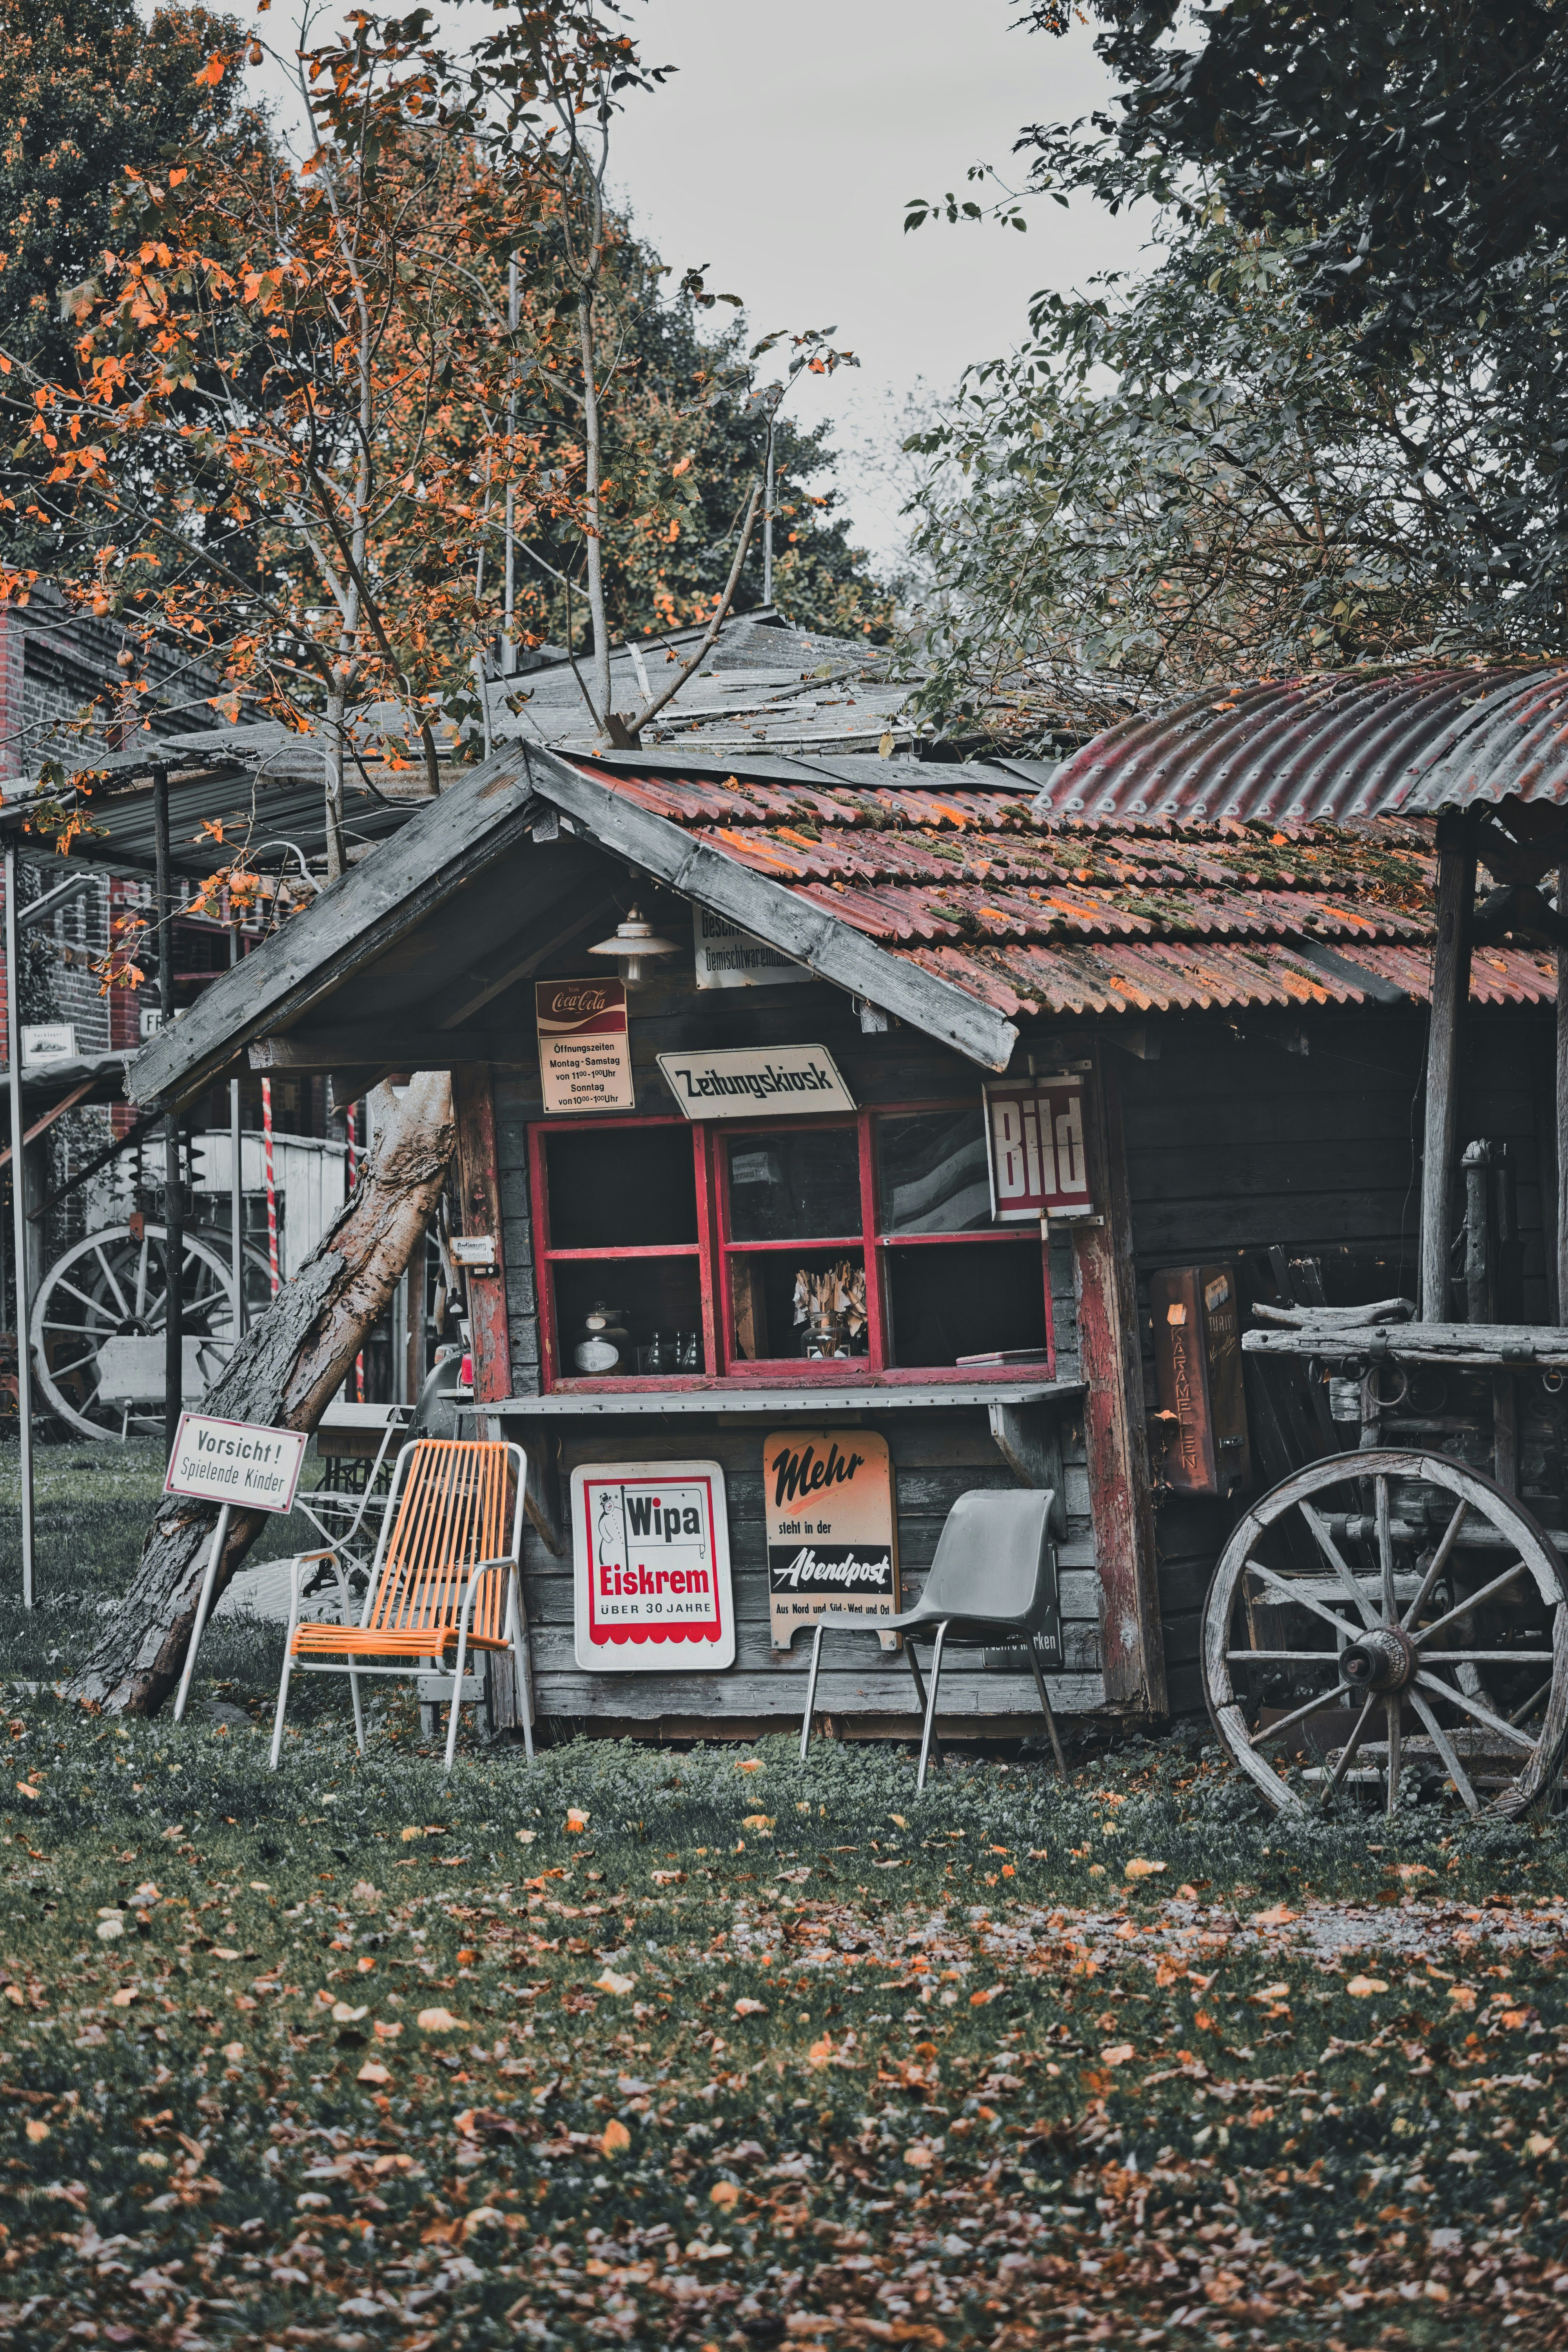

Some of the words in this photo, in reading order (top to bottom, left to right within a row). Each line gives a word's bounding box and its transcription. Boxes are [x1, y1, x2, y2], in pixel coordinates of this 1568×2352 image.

[552, 989, 607, 1012] Coca-Cola
[554, 1043, 614, 1053] Öffnungszeiten
[571, 1083, 604, 1092] Sonntag
[675, 1062, 833, 1098] Zeitungskiosk
[992, 1098, 1087, 1198] Bild
[1171, 1327, 1197, 1469] KARAMELLEN
[198, 1430, 282, 1464] Vorsicht!
[181, 1457, 239, 1484] Spielende
[245, 1468, 285, 1492] Kinder
[772, 1443, 864, 1507] Mehr
[626, 1497, 701, 1543] Wipa
[779, 1520, 801, 1534] steht
[805, 1521, 813, 1534] in
[817, 1520, 831, 1534] der
[600, 1564, 709, 1595] Eiskrem
[773, 1547, 889, 1589] Abendpost
[601, 1604, 639, 1615] ÜBER
[646, 1603, 662, 1613] 30
[667, 1603, 710, 1613] JAHRE
[777, 1604, 788, 1614] Aus
[792, 1603, 809, 1614] Nord
[813, 1603, 826, 1613] und
[848, 1603, 862, 1613] West
[866, 1604, 877, 1614] und
[880, 1604, 889, 1615] Ost
